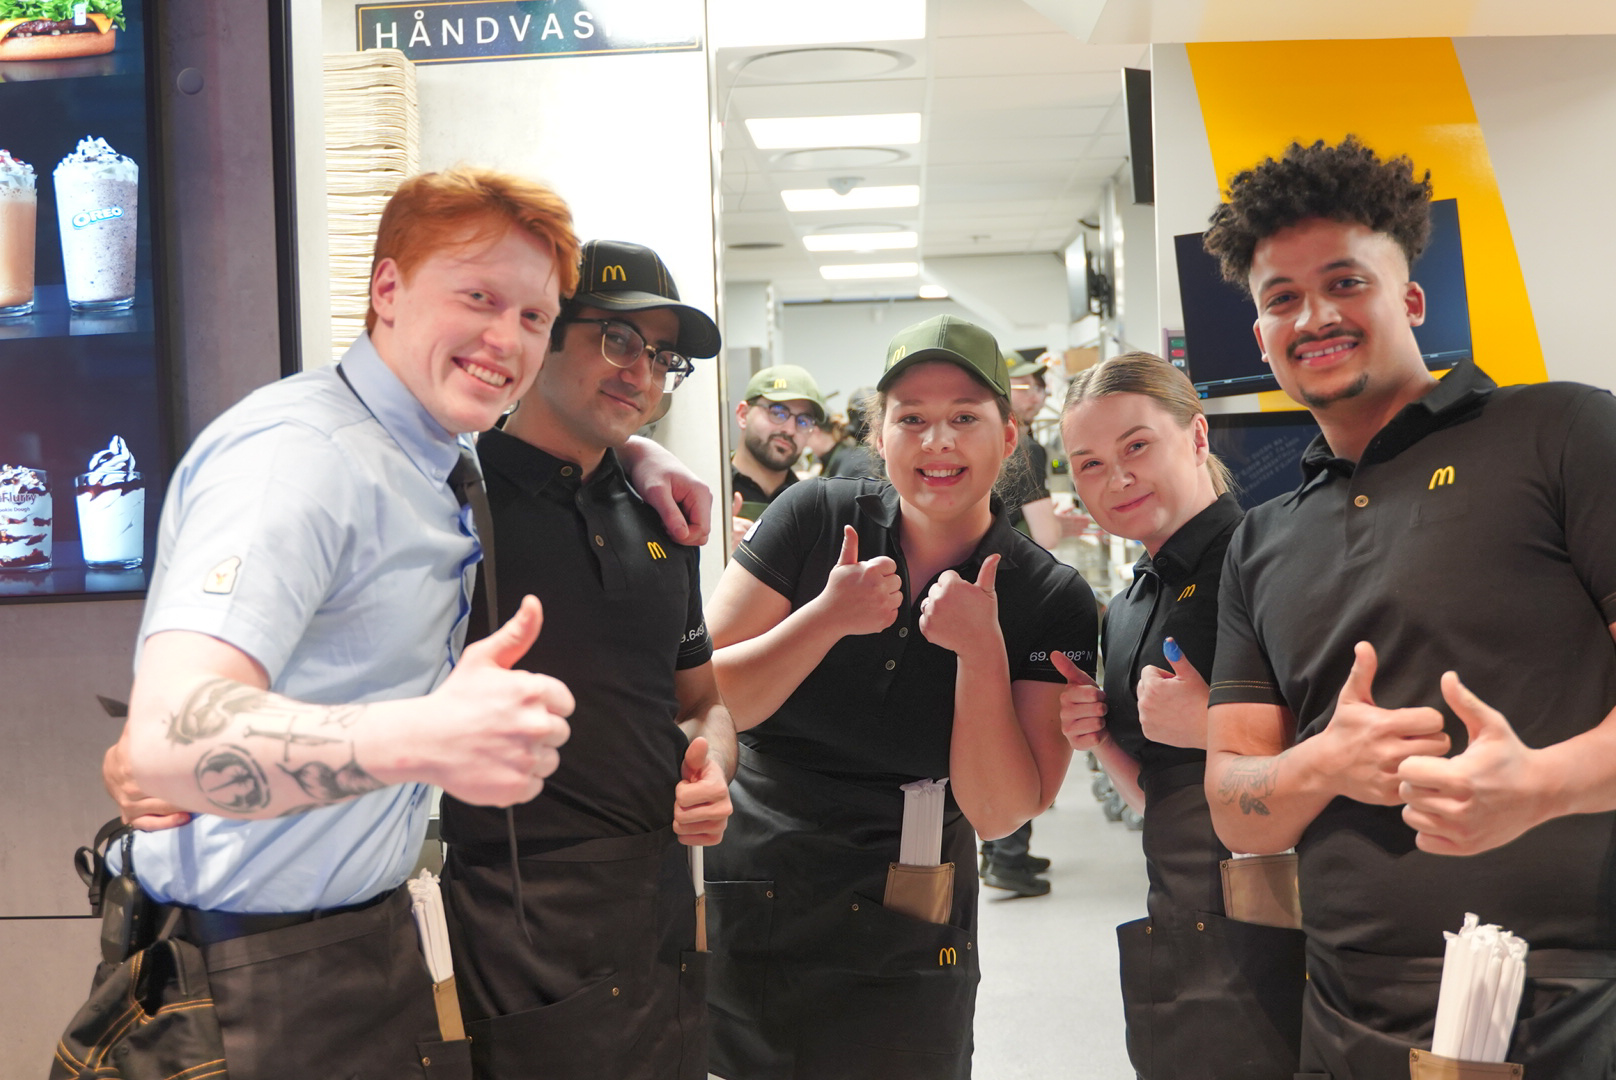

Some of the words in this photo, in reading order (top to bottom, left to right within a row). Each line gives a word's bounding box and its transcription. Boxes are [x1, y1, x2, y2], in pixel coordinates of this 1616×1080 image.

[375, 10, 612, 49] HÅNDVAS
[72, 206, 123, 229] OREO
[1029, 650, 1085, 662] 69.98°
[1086, 650, 1093, 661] N
